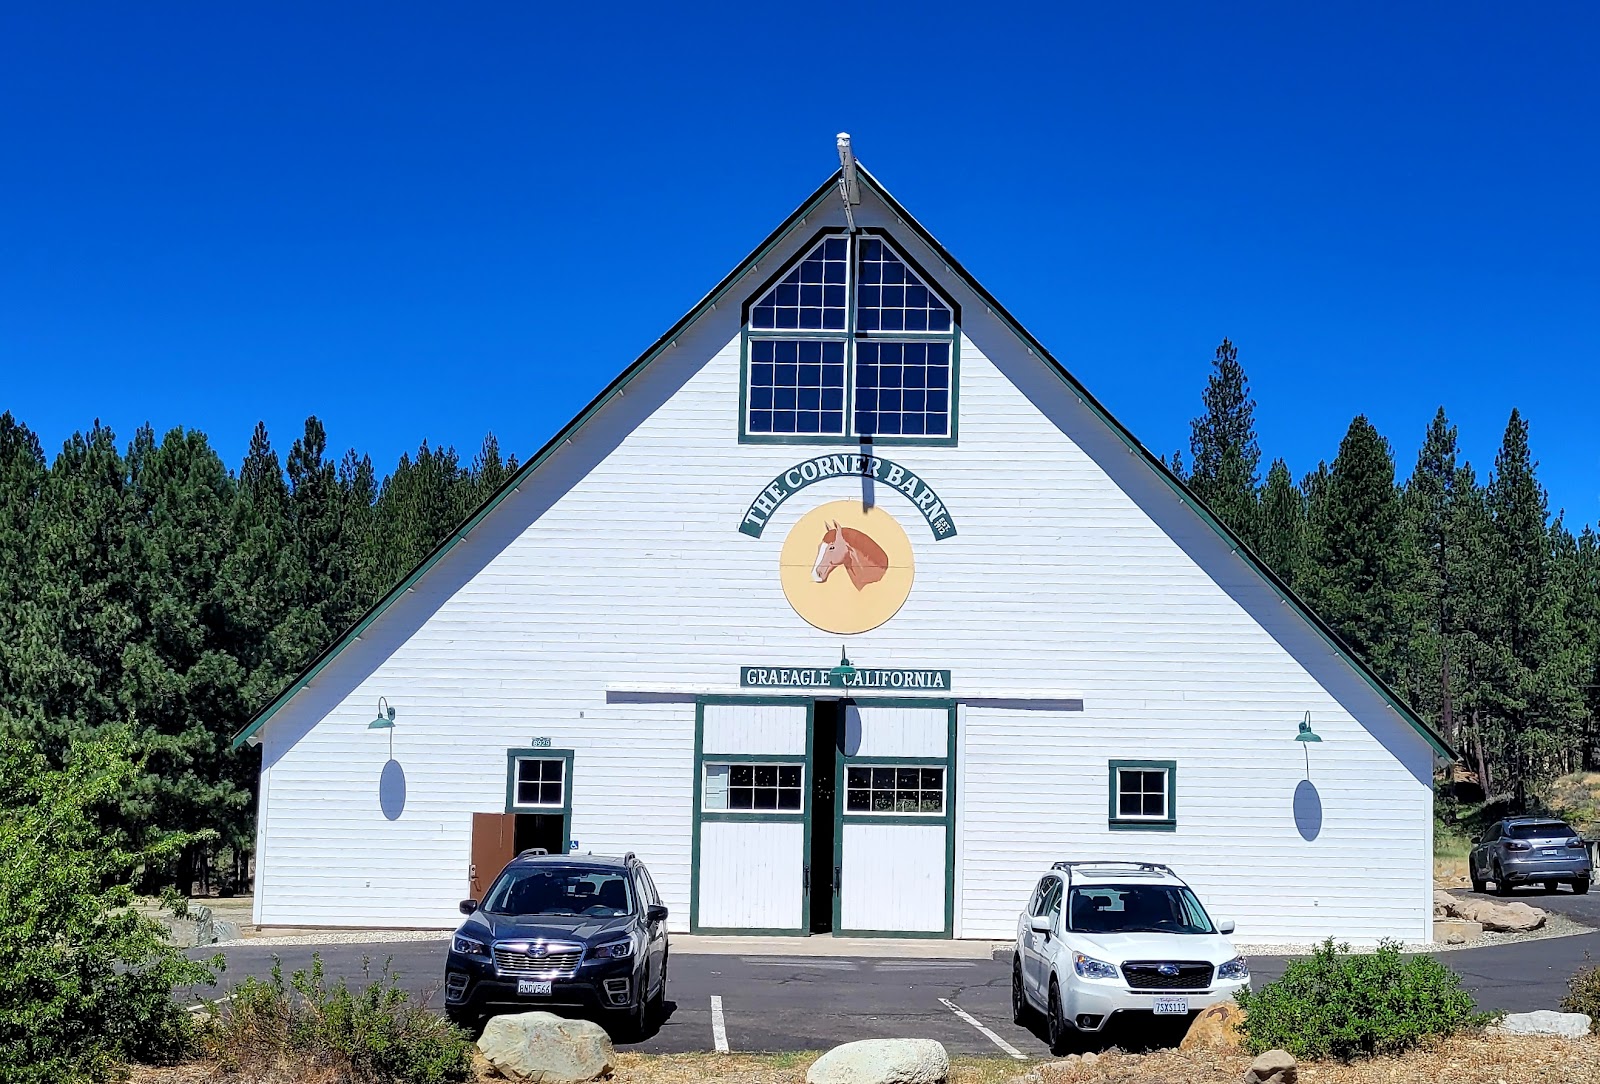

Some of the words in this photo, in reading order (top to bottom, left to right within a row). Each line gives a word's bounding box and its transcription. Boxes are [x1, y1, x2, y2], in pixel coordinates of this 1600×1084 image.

[744, 481, 788, 527] THE
[785, 454, 882, 489] CORNER
[884, 463, 947, 523] BARN
[934, 521, 946, 535] 1912
[939, 517, 951, 532] EST.
[746, 669, 831, 686] GRAEAGLE
[842, 670, 945, 688] CALIFORNIA
[1155, 1002, 1186, 1012] 7SXS113
